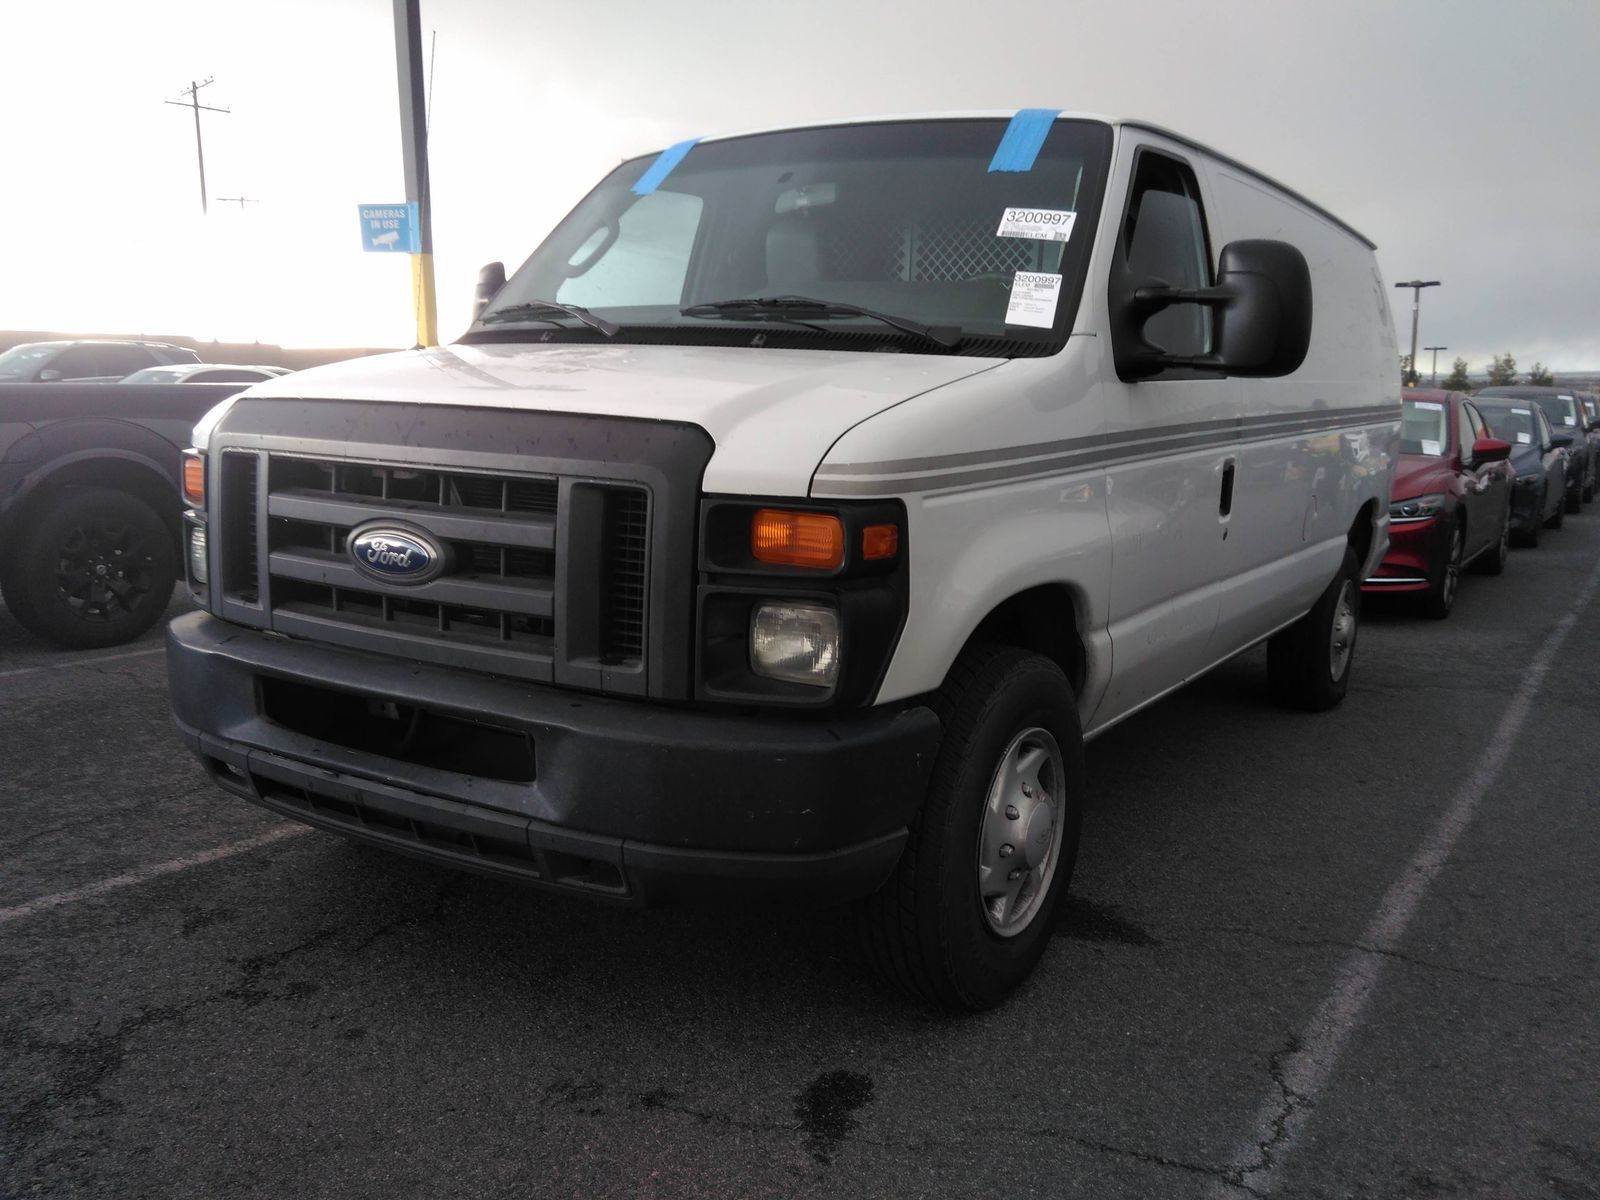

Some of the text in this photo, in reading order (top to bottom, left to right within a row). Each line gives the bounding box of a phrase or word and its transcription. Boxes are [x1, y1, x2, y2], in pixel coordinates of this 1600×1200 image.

[363, 209, 406, 219] CAMERAS
[1006, 211, 1071, 225] 3200997
[371, 219, 400, 229] IN USE
[1014, 274, 1061, 285] 3200997
[367, 539, 411, 567] Ford
